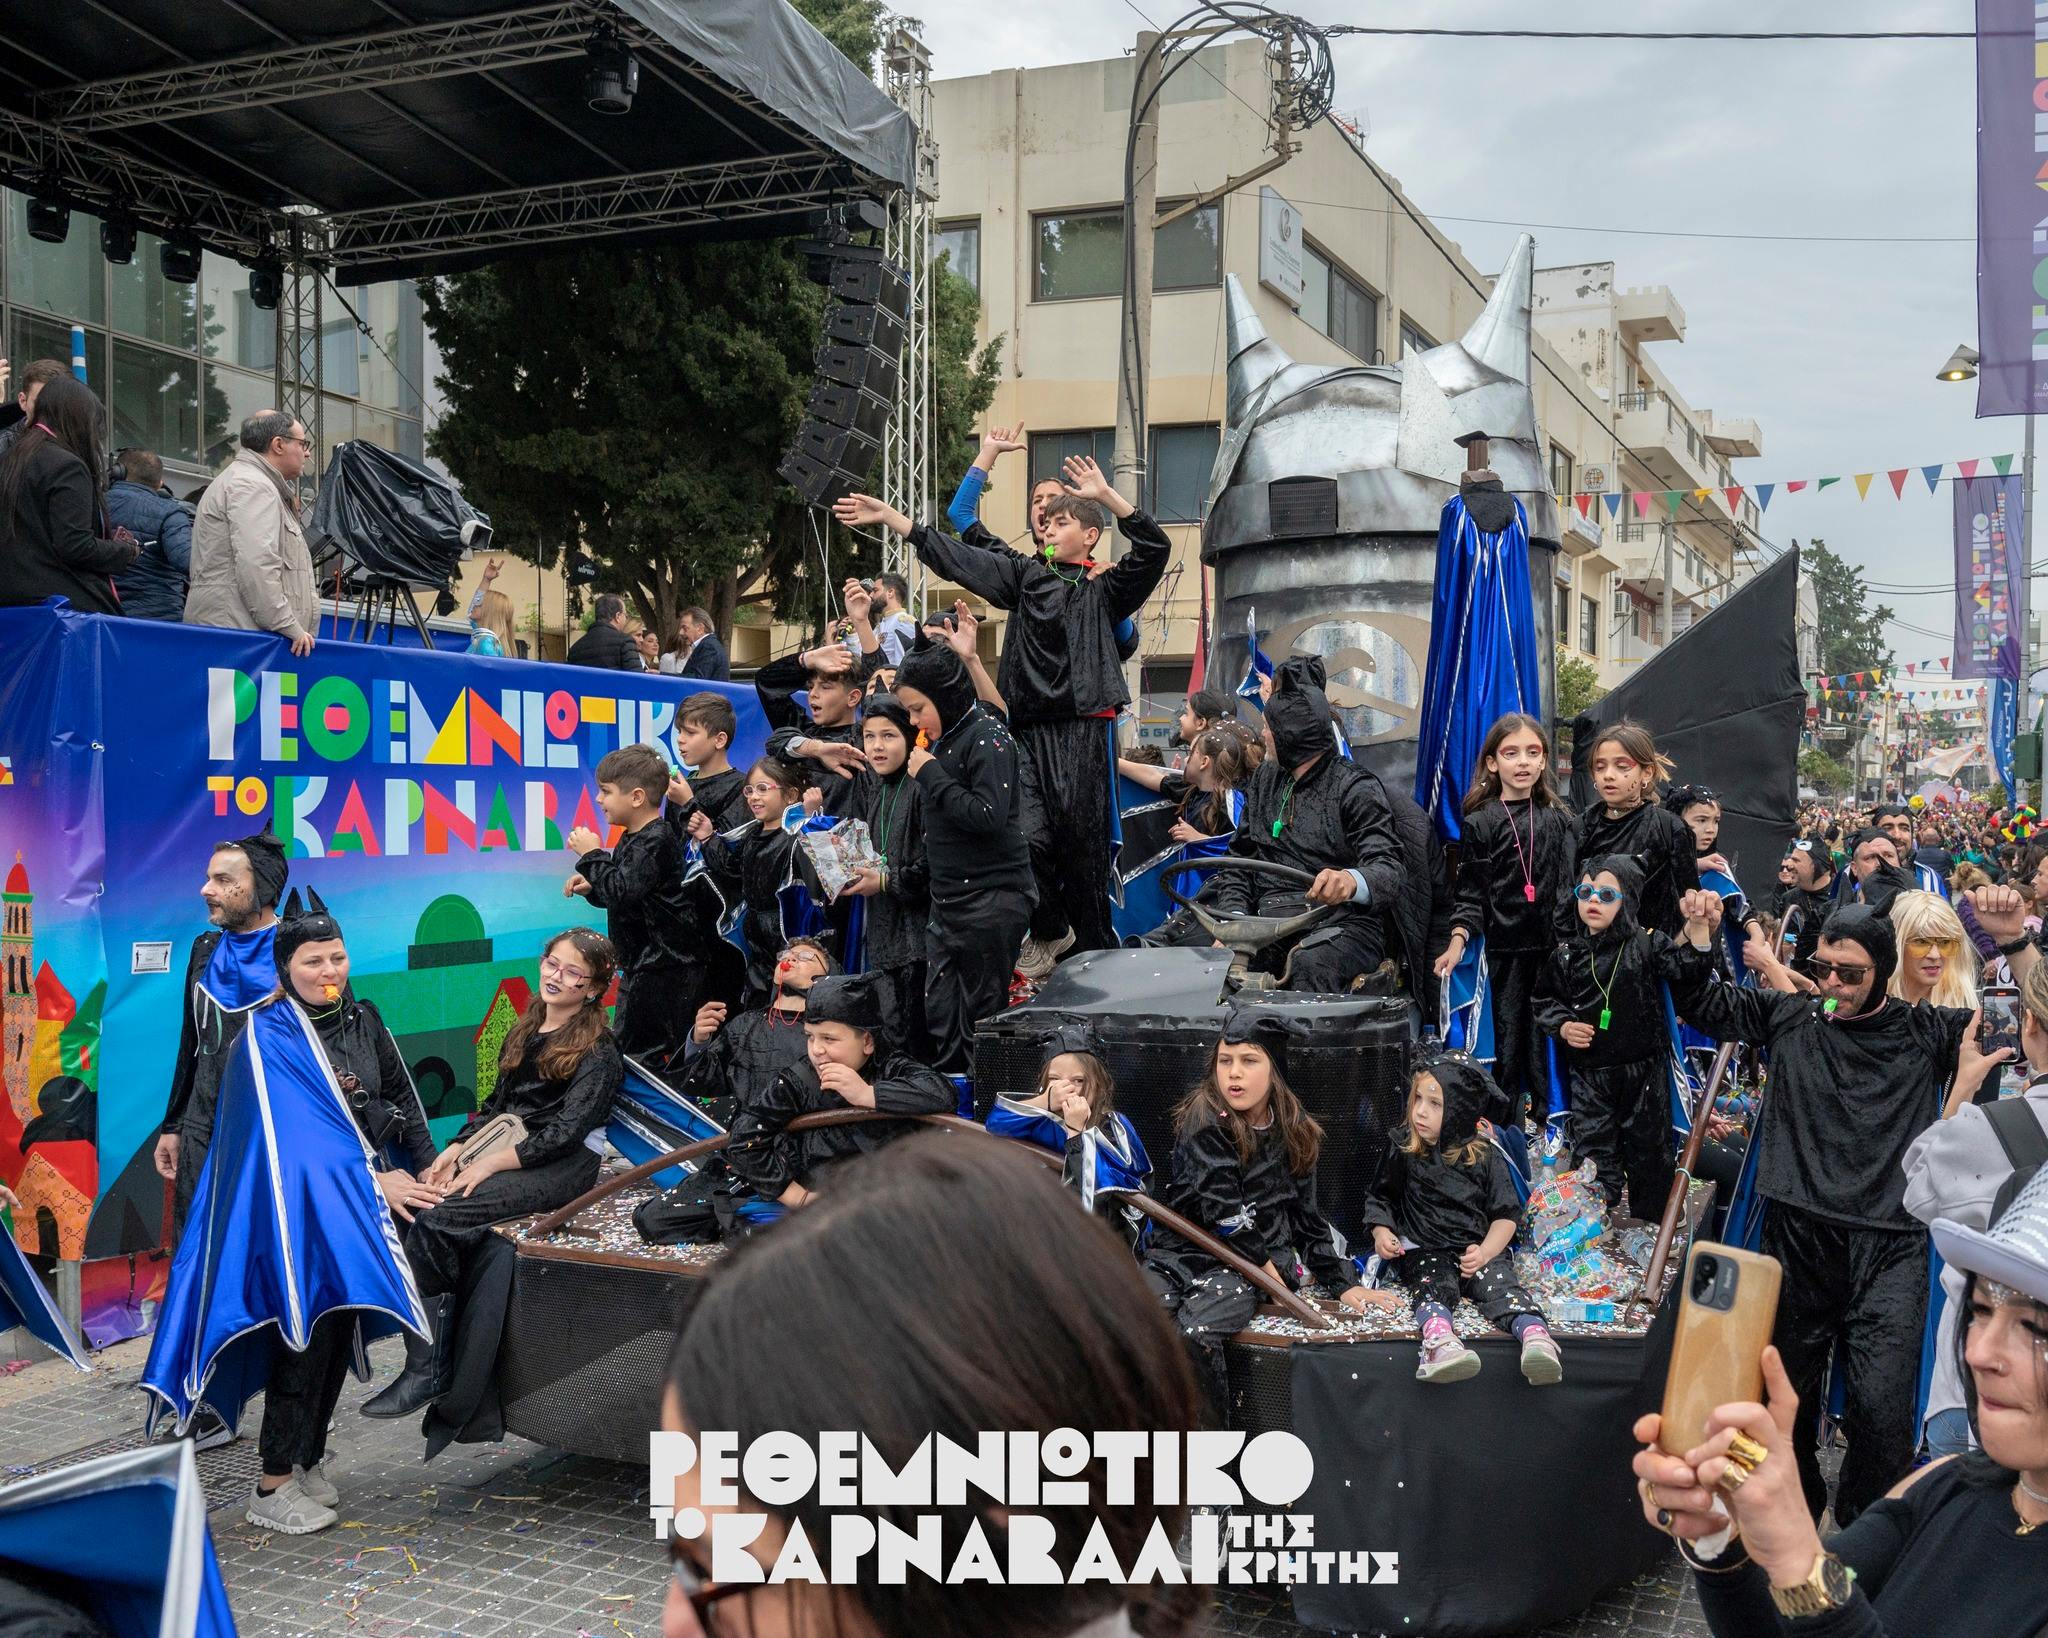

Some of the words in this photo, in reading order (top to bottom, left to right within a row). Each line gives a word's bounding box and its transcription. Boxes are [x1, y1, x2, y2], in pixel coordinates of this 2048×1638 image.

[207, 667, 700, 772] ΡΕΘΕΜΝΙΩΤΙΚ
[207, 776, 268, 816] ΤΟ
[274, 776, 628, 858] ΚΑΡΝΑΒΑ
